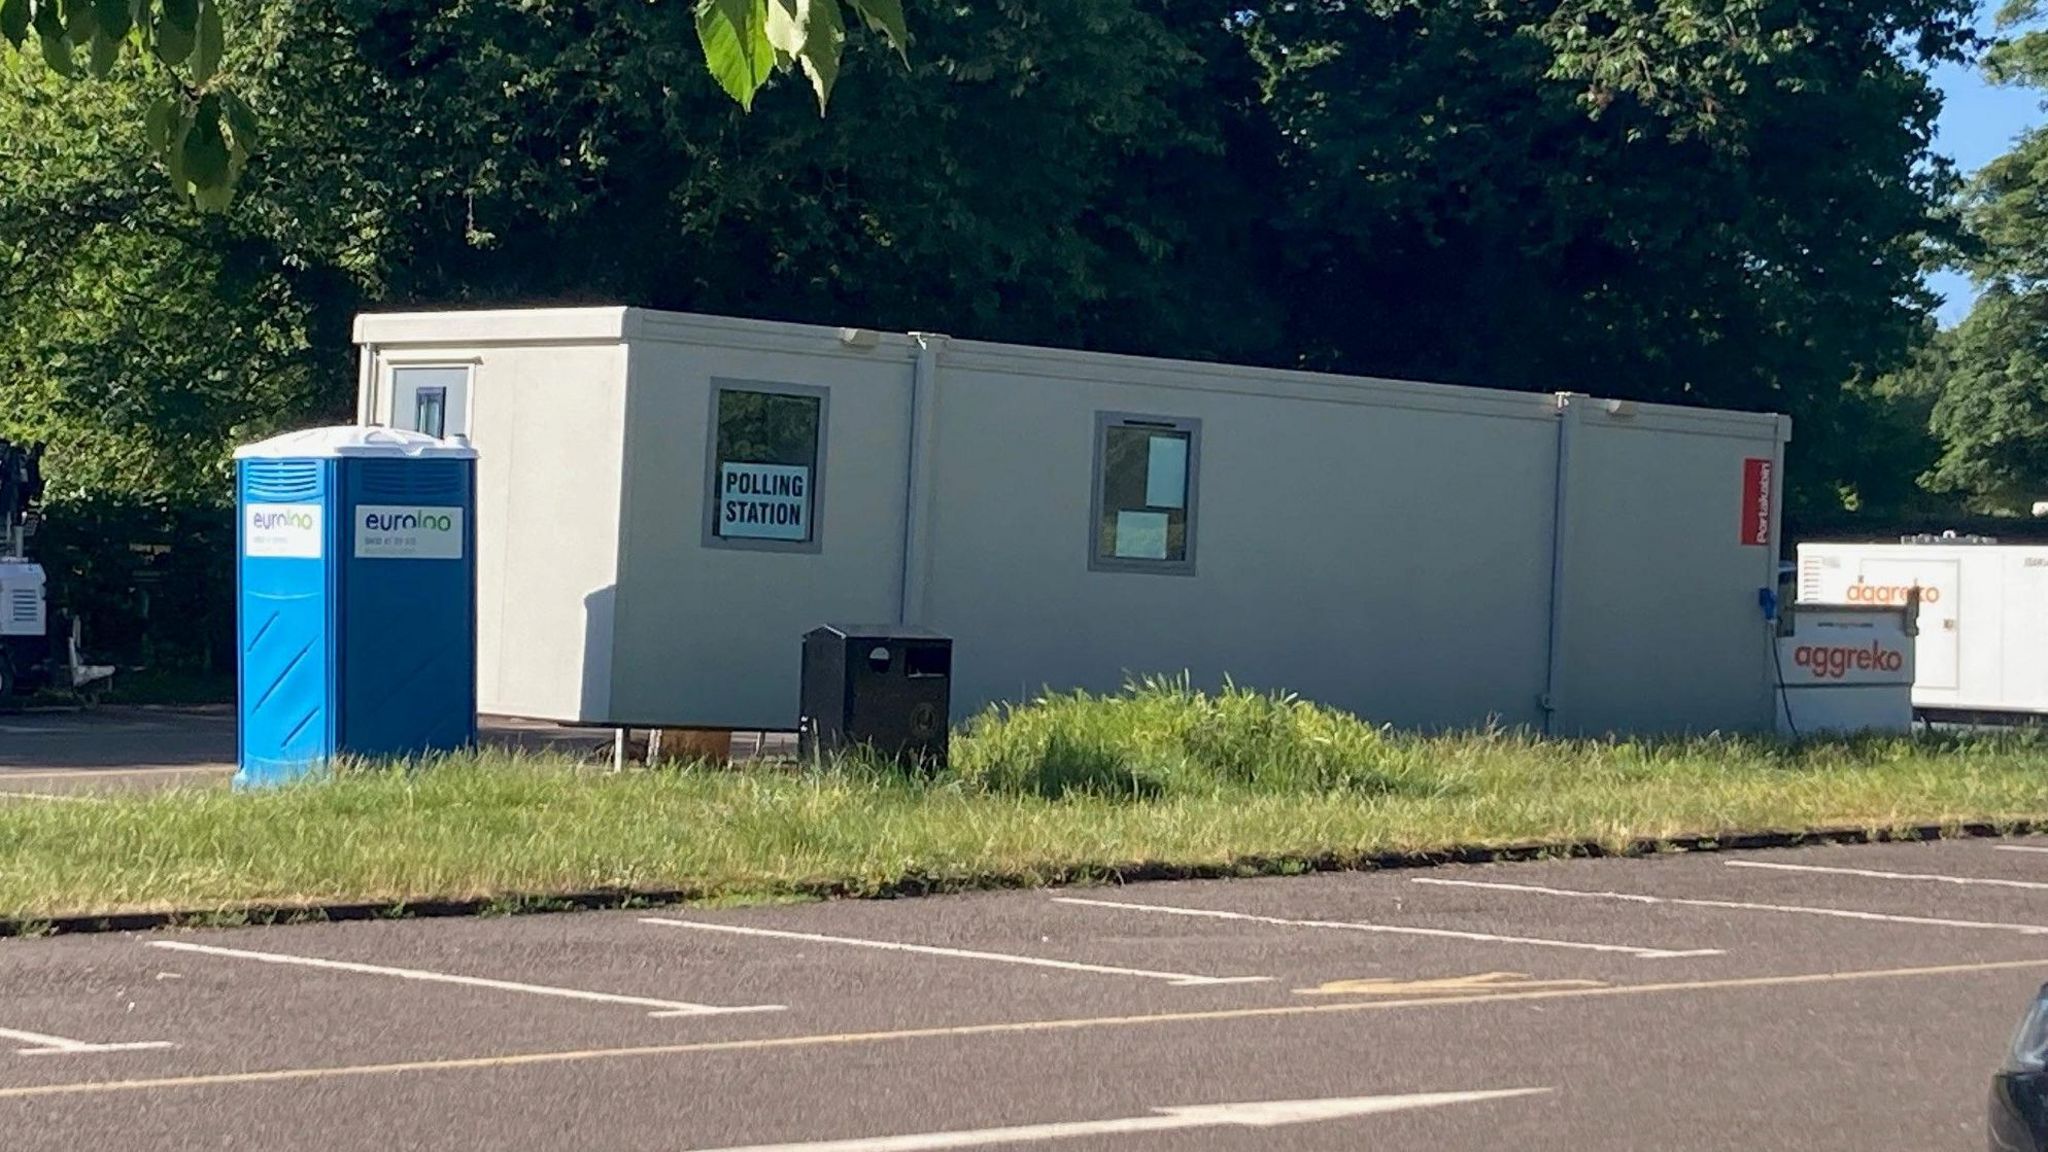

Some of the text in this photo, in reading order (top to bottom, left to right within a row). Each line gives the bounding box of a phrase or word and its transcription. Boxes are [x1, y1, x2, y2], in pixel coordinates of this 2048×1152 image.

[726, 471, 804, 498] POLLING
[253, 509, 313, 531] euroloo
[365, 509, 452, 532] euroloo
[725, 500, 801, 526] STATION
[1794, 640, 1903, 678] aggreko
